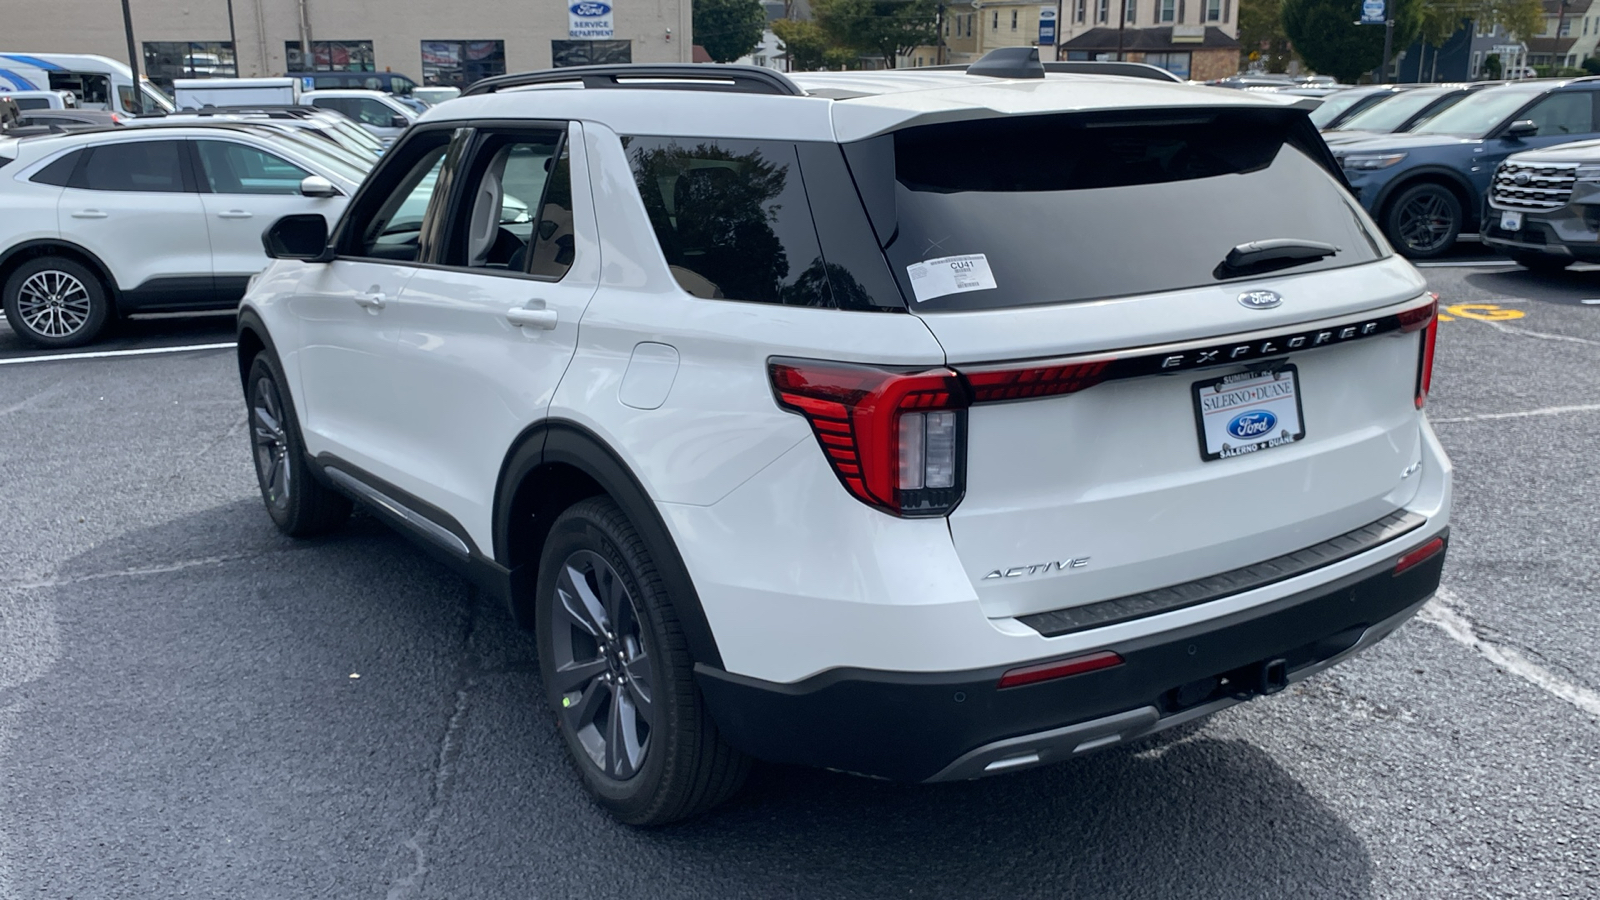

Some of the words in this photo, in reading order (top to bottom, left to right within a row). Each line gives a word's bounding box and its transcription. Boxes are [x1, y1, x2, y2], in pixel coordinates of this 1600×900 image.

[577, 3, 604, 15] Ford
[950, 261, 974, 270] CU41
[1250, 292, 1276, 305] Ford
[1162, 322, 1378, 369] EXPLORER
[1203, 391, 1251, 411] SALERNO
[1255, 381, 1292, 398] DUANE
[1237, 414, 1268, 436] Ford
[1220, 443, 1258, 459] SALERNO
[1268, 434, 1295, 448] DUANE
[981, 556, 1091, 580] ACTIVE
